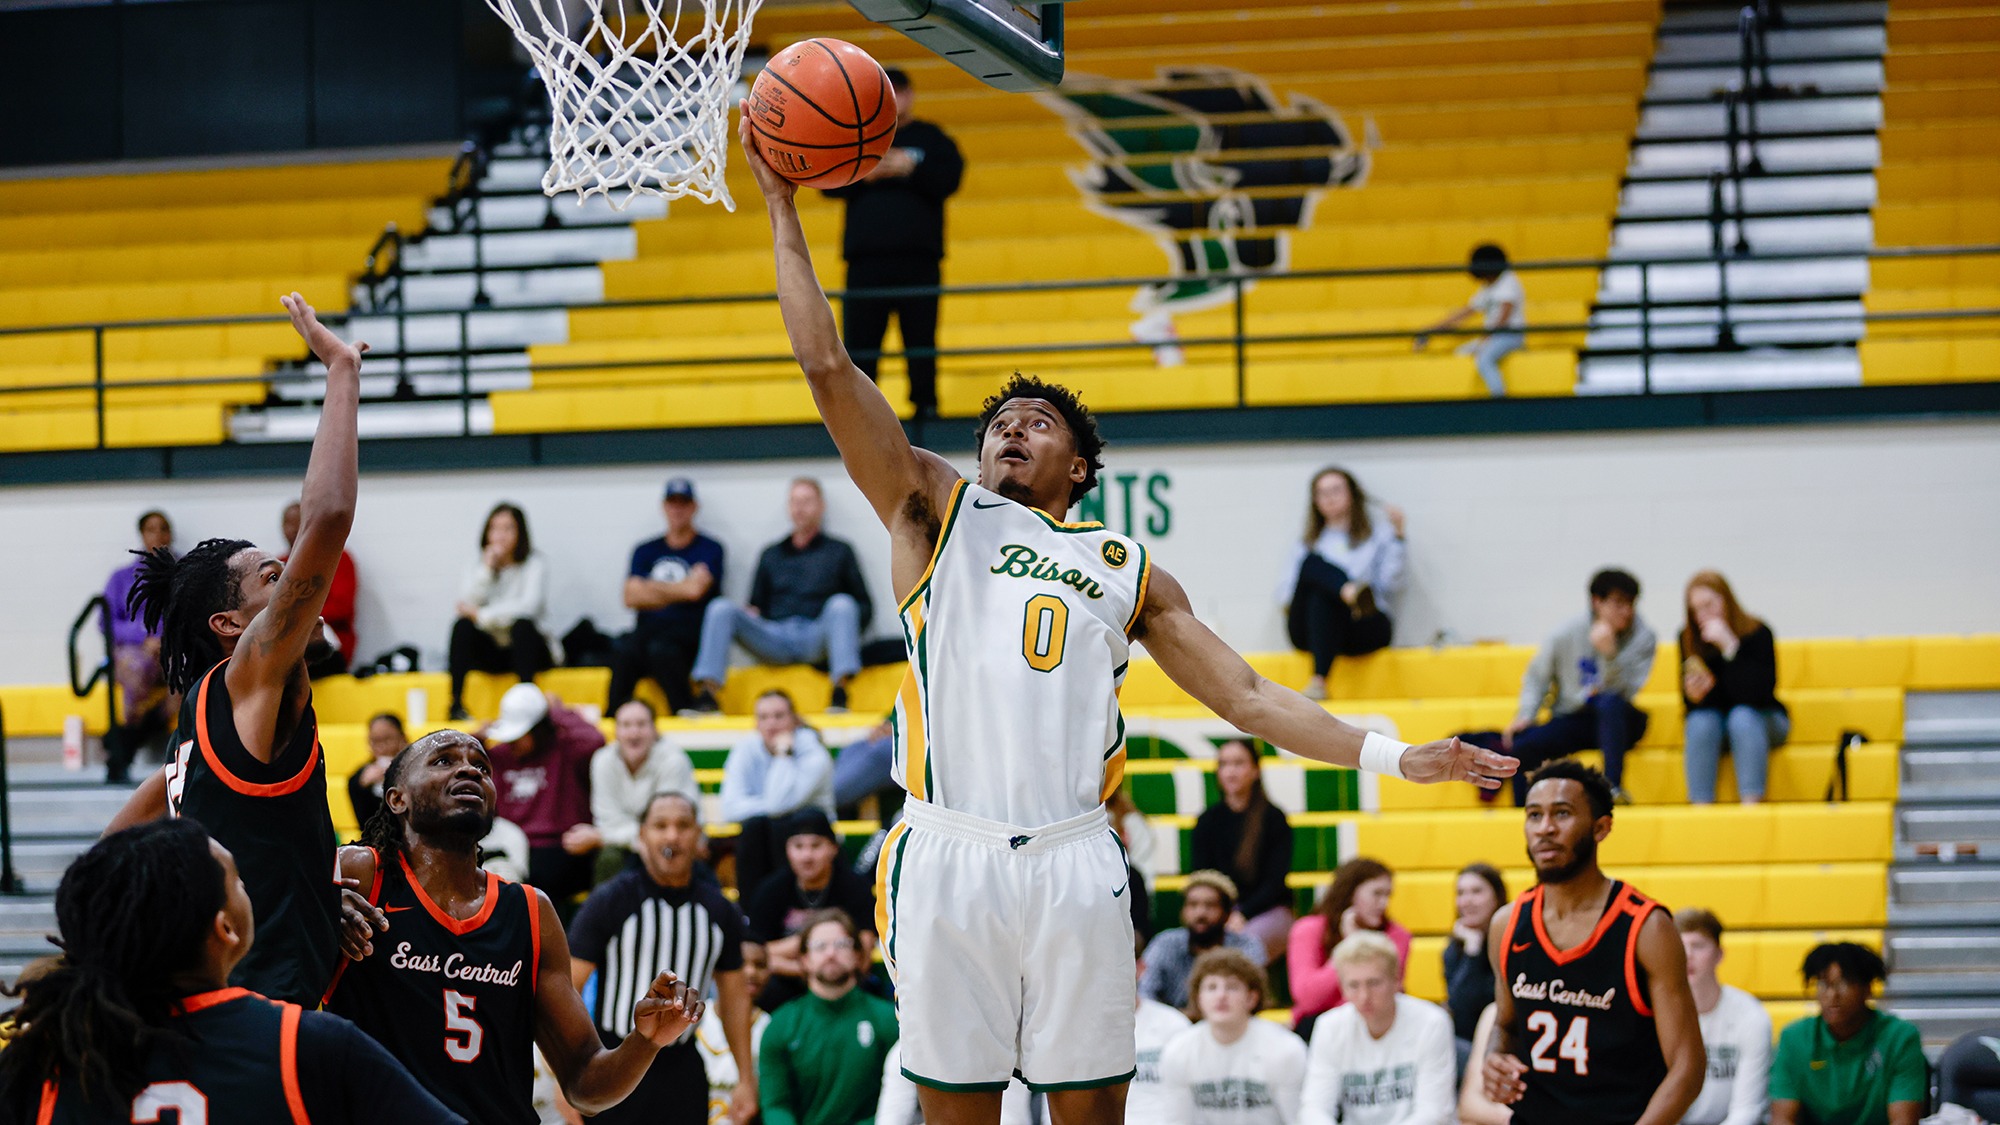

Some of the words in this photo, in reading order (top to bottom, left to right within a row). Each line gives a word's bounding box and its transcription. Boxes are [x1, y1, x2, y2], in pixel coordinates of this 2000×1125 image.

[768, 147, 811, 173] THE
[990, 544, 1104, 599] Bison
[1105, 543, 1125, 565] AE
[1022, 593, 1069, 673] 0
[390, 941, 441, 973] East
[443, 952, 523, 987] Central
[1511, 972, 1547, 999] East
[1549, 978, 1616, 1010] Central
[442, 988, 484, 1064] 5
[1526, 1010, 1589, 1076] 24
